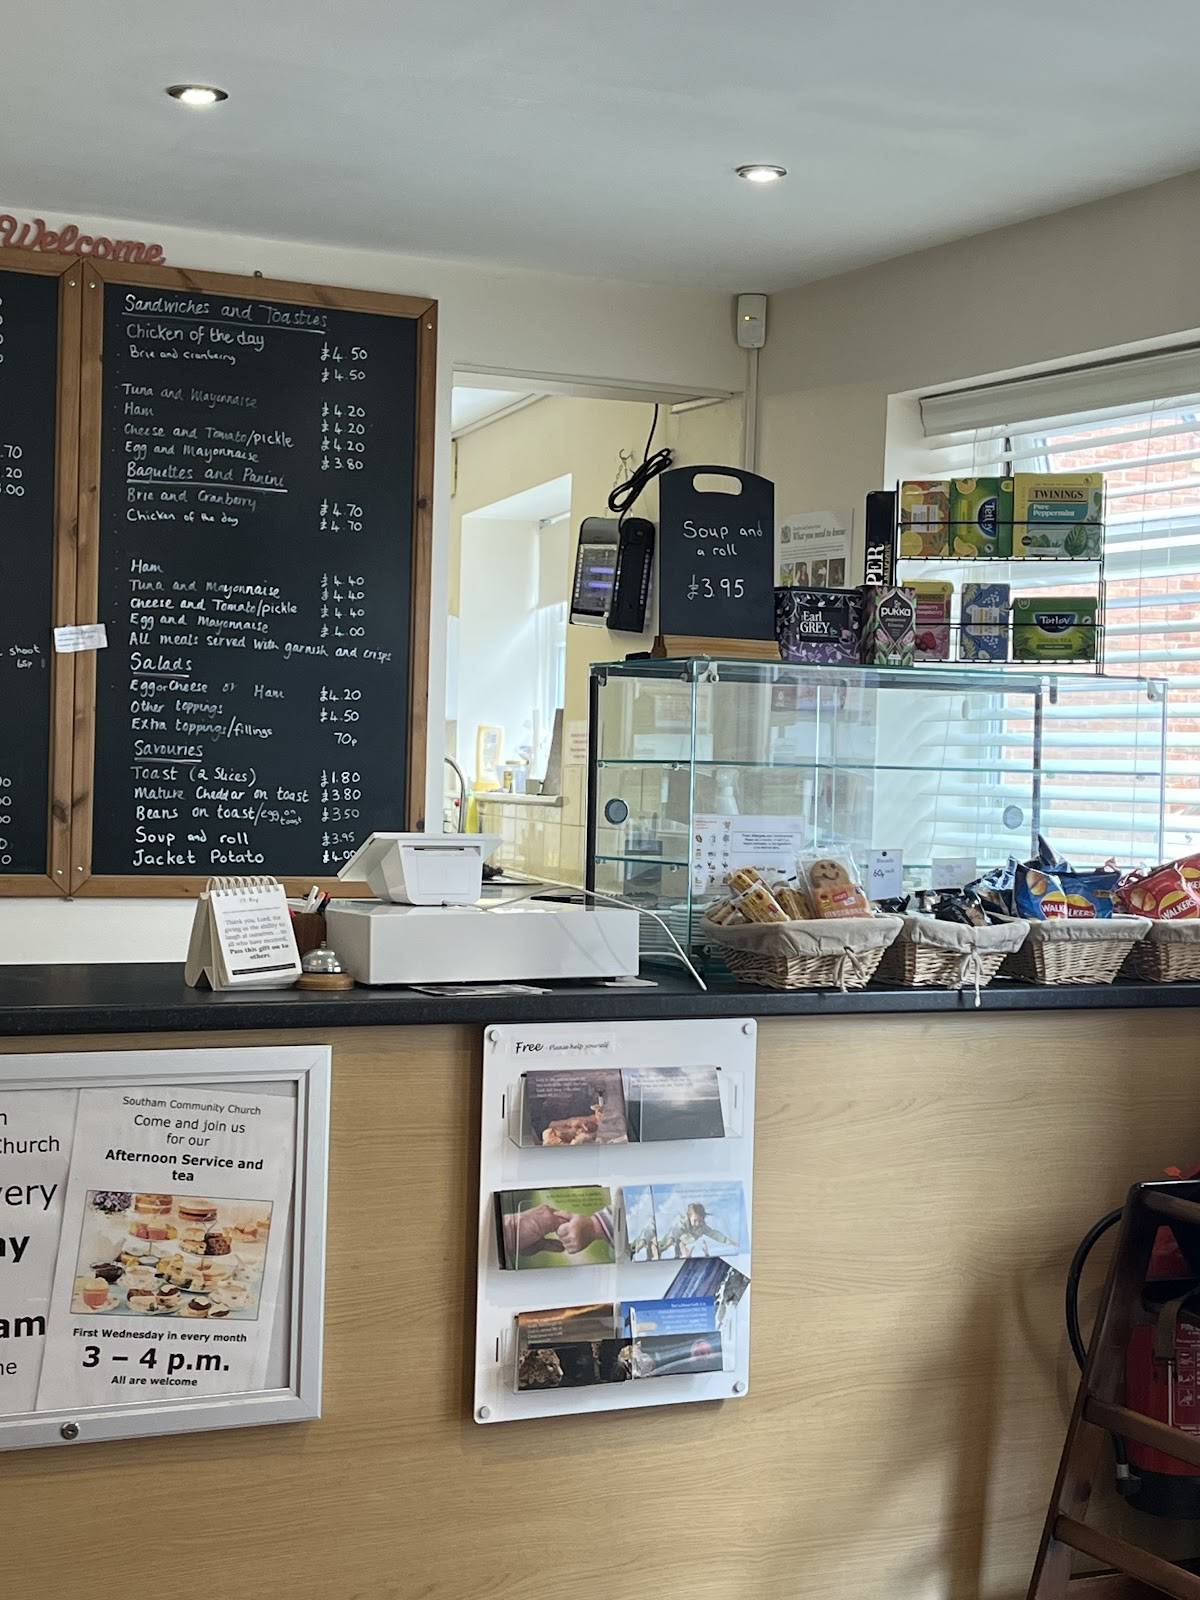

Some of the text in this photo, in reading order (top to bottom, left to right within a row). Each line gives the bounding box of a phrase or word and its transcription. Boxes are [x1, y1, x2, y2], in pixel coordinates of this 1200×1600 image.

[0, 215, 166, 265] Welcome
[125, 295, 327, 327] Sandwiches and Toasties
[127, 324, 265, 351] Chicken of the day
[130, 346, 236, 365] Brie and cranberry
[122, 383, 257, 408] Tuna and Mayonnaise
[124, 402, 154, 416] Ham
[124, 424, 295, 447] Cheese and Tomato/pickle
[126, 440, 259, 463] Egg and Mayonnaise
[127, 463, 284, 486] Baguettes and Panini
[128, 489, 256, 510] Brie and Cranberry
[1034, 490, 1083, 498] TWININGS
[127, 509, 238, 526] Chicken of the day
[683, 520, 762, 540] Soup and
[713, 543, 737, 557] roll
[131, 560, 164, 573] Ham
[130, 580, 280, 599] Tuna and Mayonnaise
[687, 574, 744, 600] £3.95
[130, 598, 298, 616] Cheese and Tomato/pickle
[803, 610, 822, 622] Earl
[881, 607, 911, 617] pukka
[130, 614, 270, 633] Egg and Mayonnaise
[800, 622, 831, 634] GREY
[130, 633, 392, 663] All meals served with garnish and crisps
[130, 652, 192, 671] Salads
[254, 686, 284, 699] Ham
[130, 700, 223, 718] Other toppings
[132, 716, 273, 742] Extra toppings/fillings
[134, 740, 203, 757] Savouries
[334, 733, 358, 748] 70p
[130, 767, 178, 780] Toast
[190, 767, 208, 782] (2
[320, 772, 360, 788] £1.80
[134, 786, 310, 802] Mature Cheddar on toast
[136, 806, 178, 820] Beans
[192, 807, 208, 818] on
[136, 826, 249, 846] Soup and roll
[322, 832, 355, 846] £3.95
[133, 850, 264, 866] Jacket Potato
[1160, 899, 1196, 920] WALKERS
[516, 1041, 543, 1054] Free
[123, 1096, 261, 1115] Southam Community Church
[134, 1114, 245, 1133] Come and join us
[167, 1133, 210, 1146] for our
[105, 1150, 263, 1169] Afternoon Service and
[172, 1169, 194, 1182] tea
[0, 1183, 57, 1210] ery
[73, 1328, 246, 1342] First Wednesday in every month
[82, 1345, 229, 1374] 3 4 p.m.
[112, 1375, 197, 1386] All are welcome
